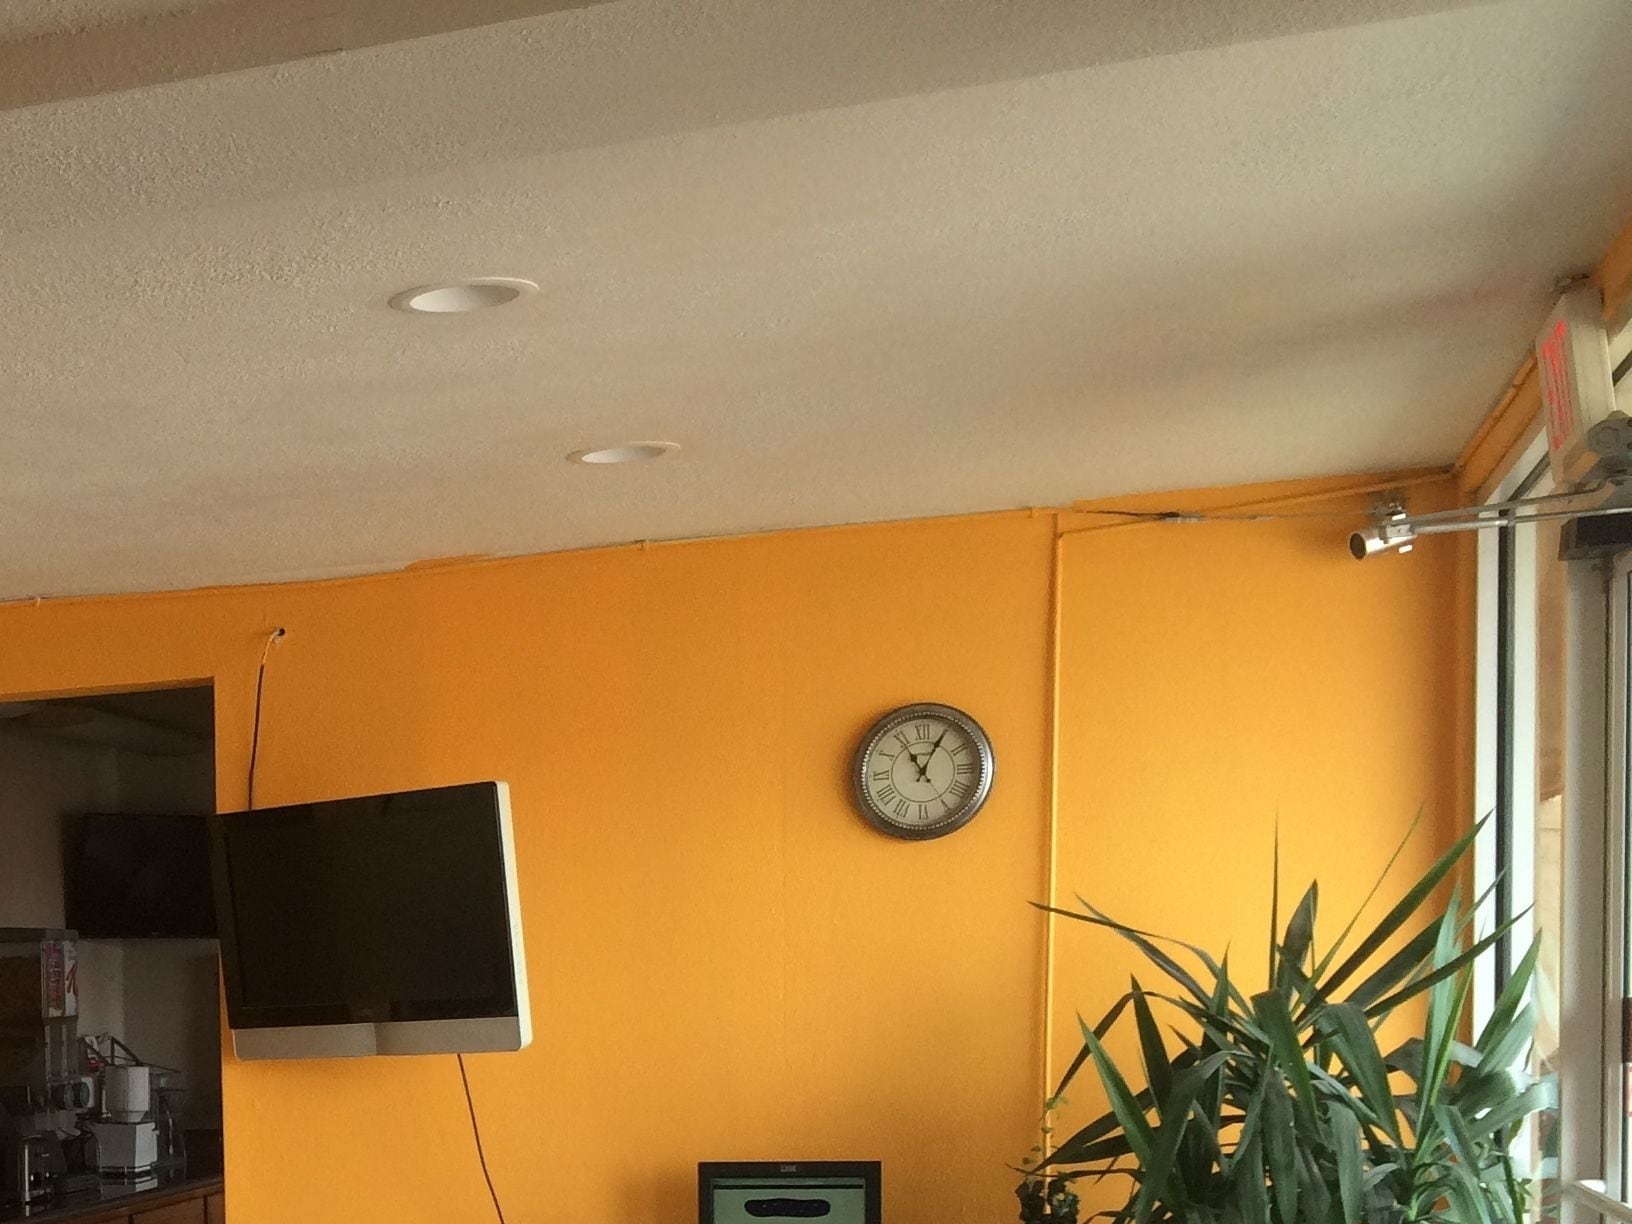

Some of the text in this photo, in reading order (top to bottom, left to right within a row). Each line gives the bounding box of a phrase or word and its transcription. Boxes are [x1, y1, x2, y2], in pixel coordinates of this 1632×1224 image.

[915, 723, 930, 741] XII
[894, 731, 910, 748] XI
[879, 750, 895, 760] X
[951, 743, 968, 756] II
[873, 769, 890, 782] IX
[957, 763, 974, 775] III
[918, 804, 929, 820] VI
